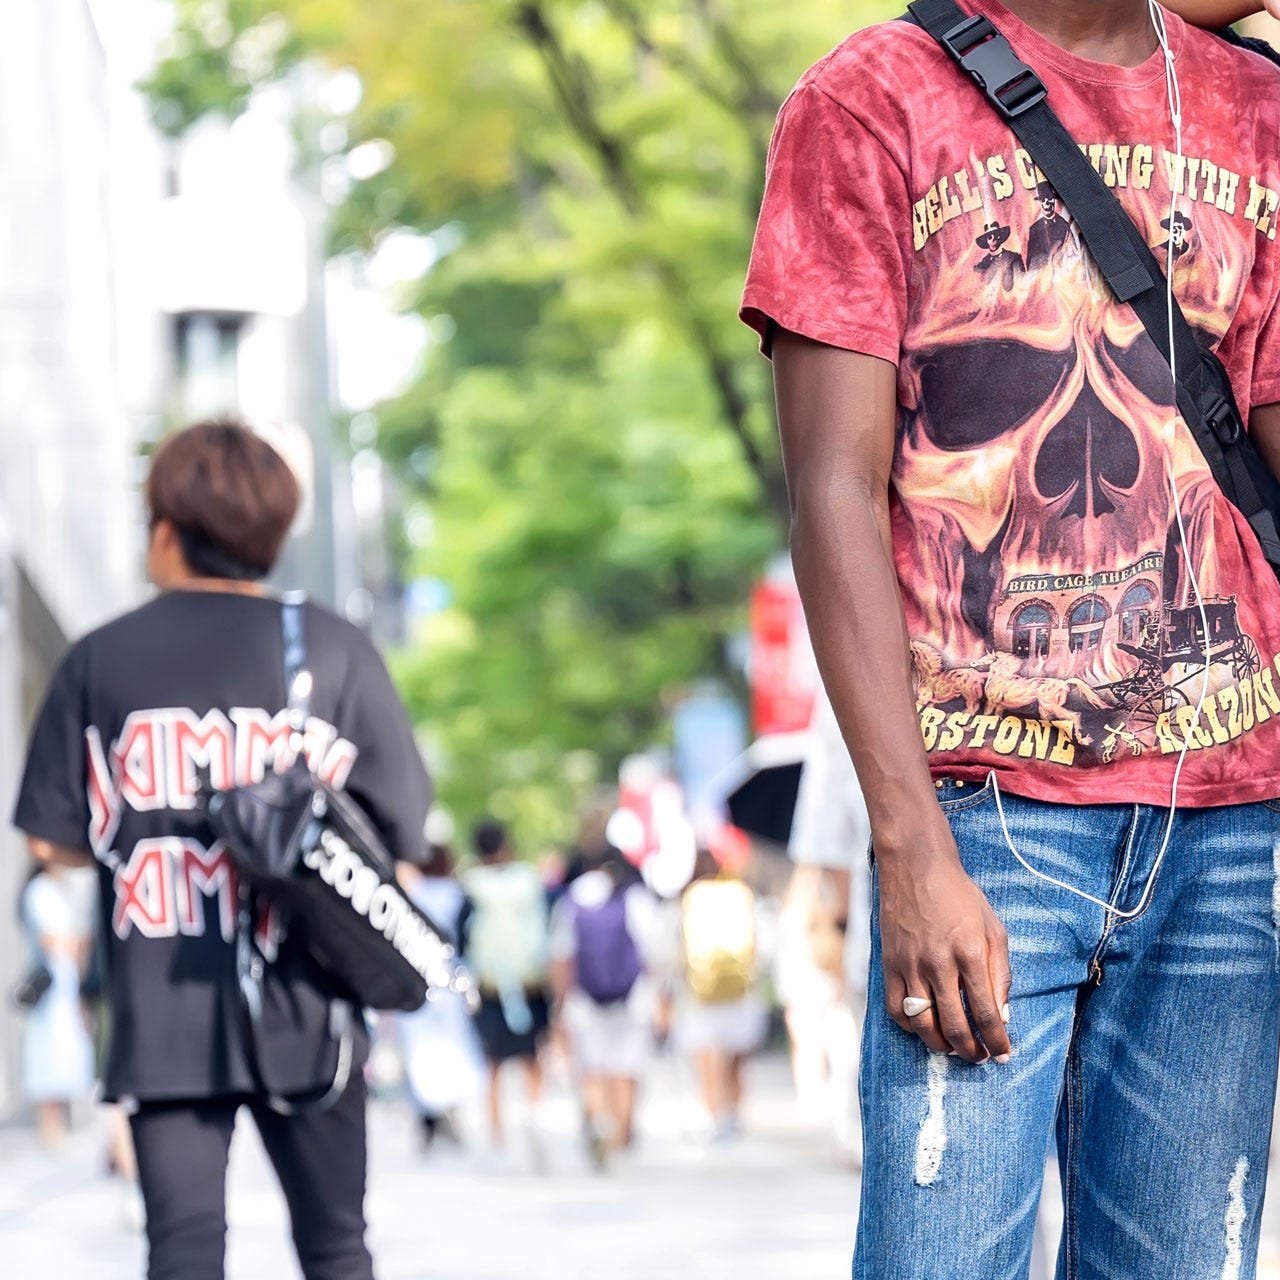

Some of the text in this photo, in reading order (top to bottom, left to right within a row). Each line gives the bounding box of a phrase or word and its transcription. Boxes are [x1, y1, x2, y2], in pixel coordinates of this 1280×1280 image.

[912, 153, 1014, 251] HELL'S
[1014, 143, 1155, 190] CING
[1162, 150, 1240, 216] WITH
[1008, 556, 1164, 592] BIRD CAGE THEATRE
[916, 703, 1076, 766] BSTONE
